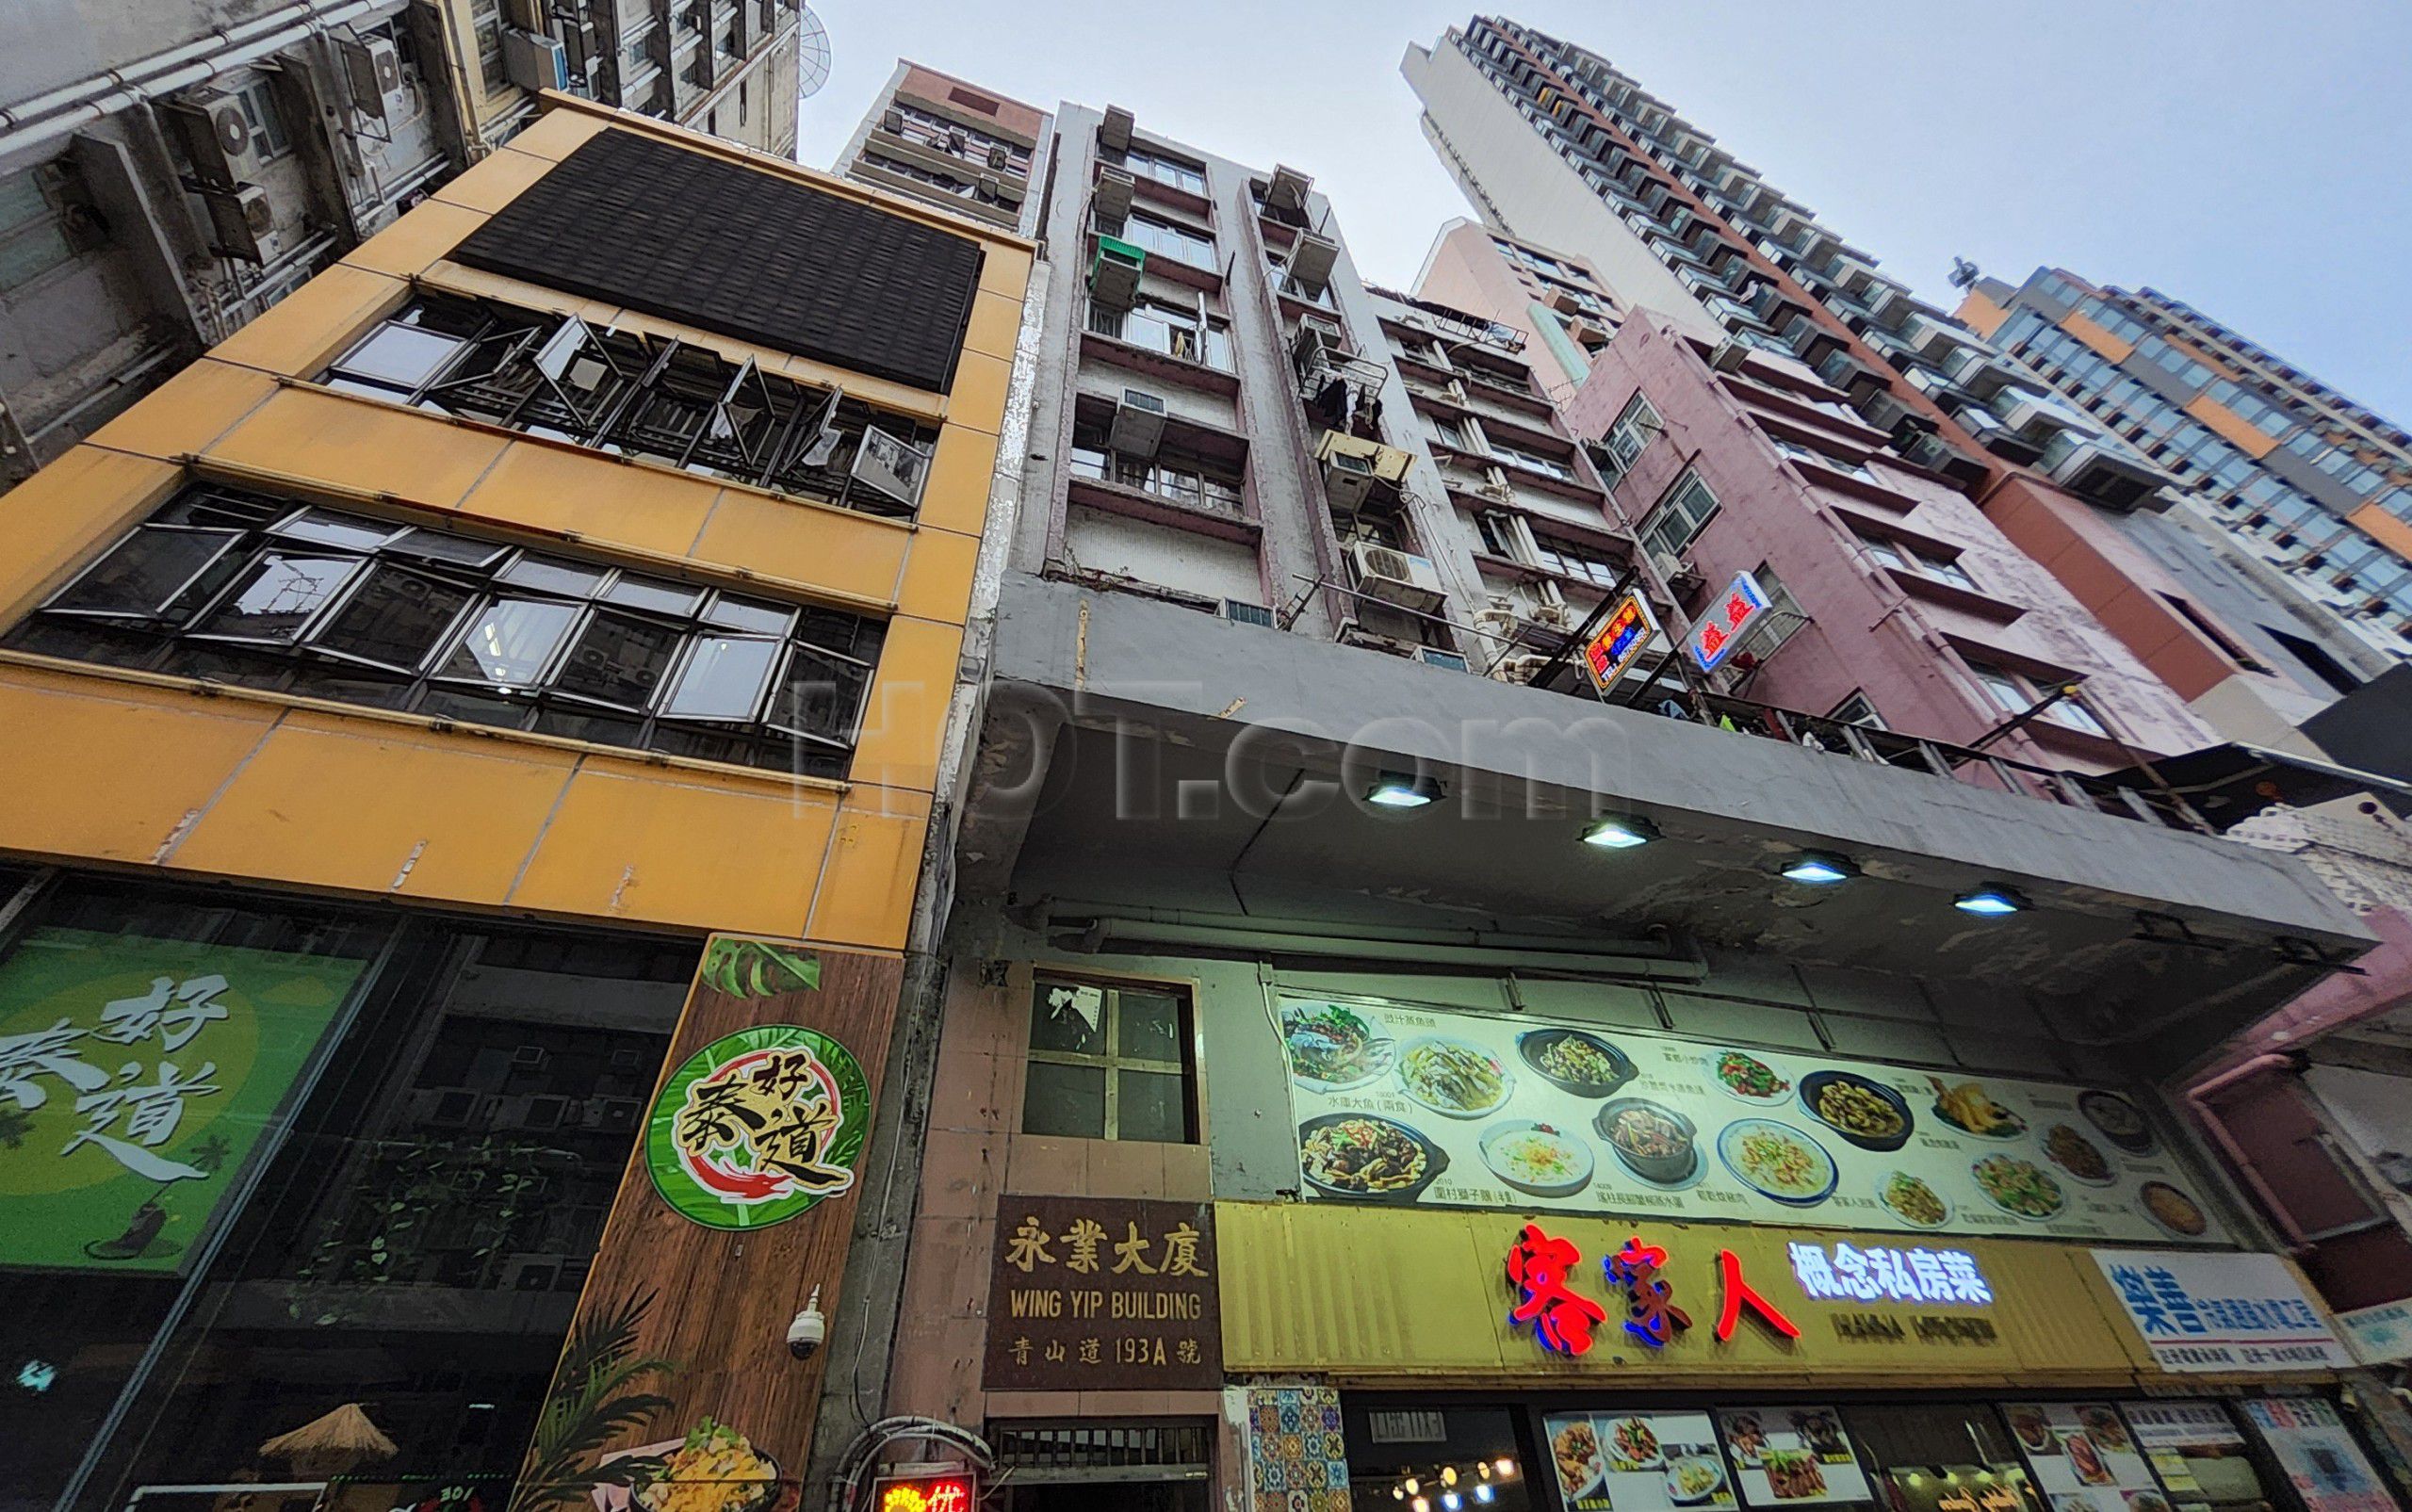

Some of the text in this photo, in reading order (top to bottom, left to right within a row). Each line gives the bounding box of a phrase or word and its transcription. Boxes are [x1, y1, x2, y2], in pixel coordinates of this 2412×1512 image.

[1005, 1216, 1209, 1277] 永業大廈
[1788, 1241, 1993, 1305] 概念私房菜
[1010, 1289, 1202, 1320] WING YIP BUILDING
[1508, 1224, 1801, 1356] 客家人
